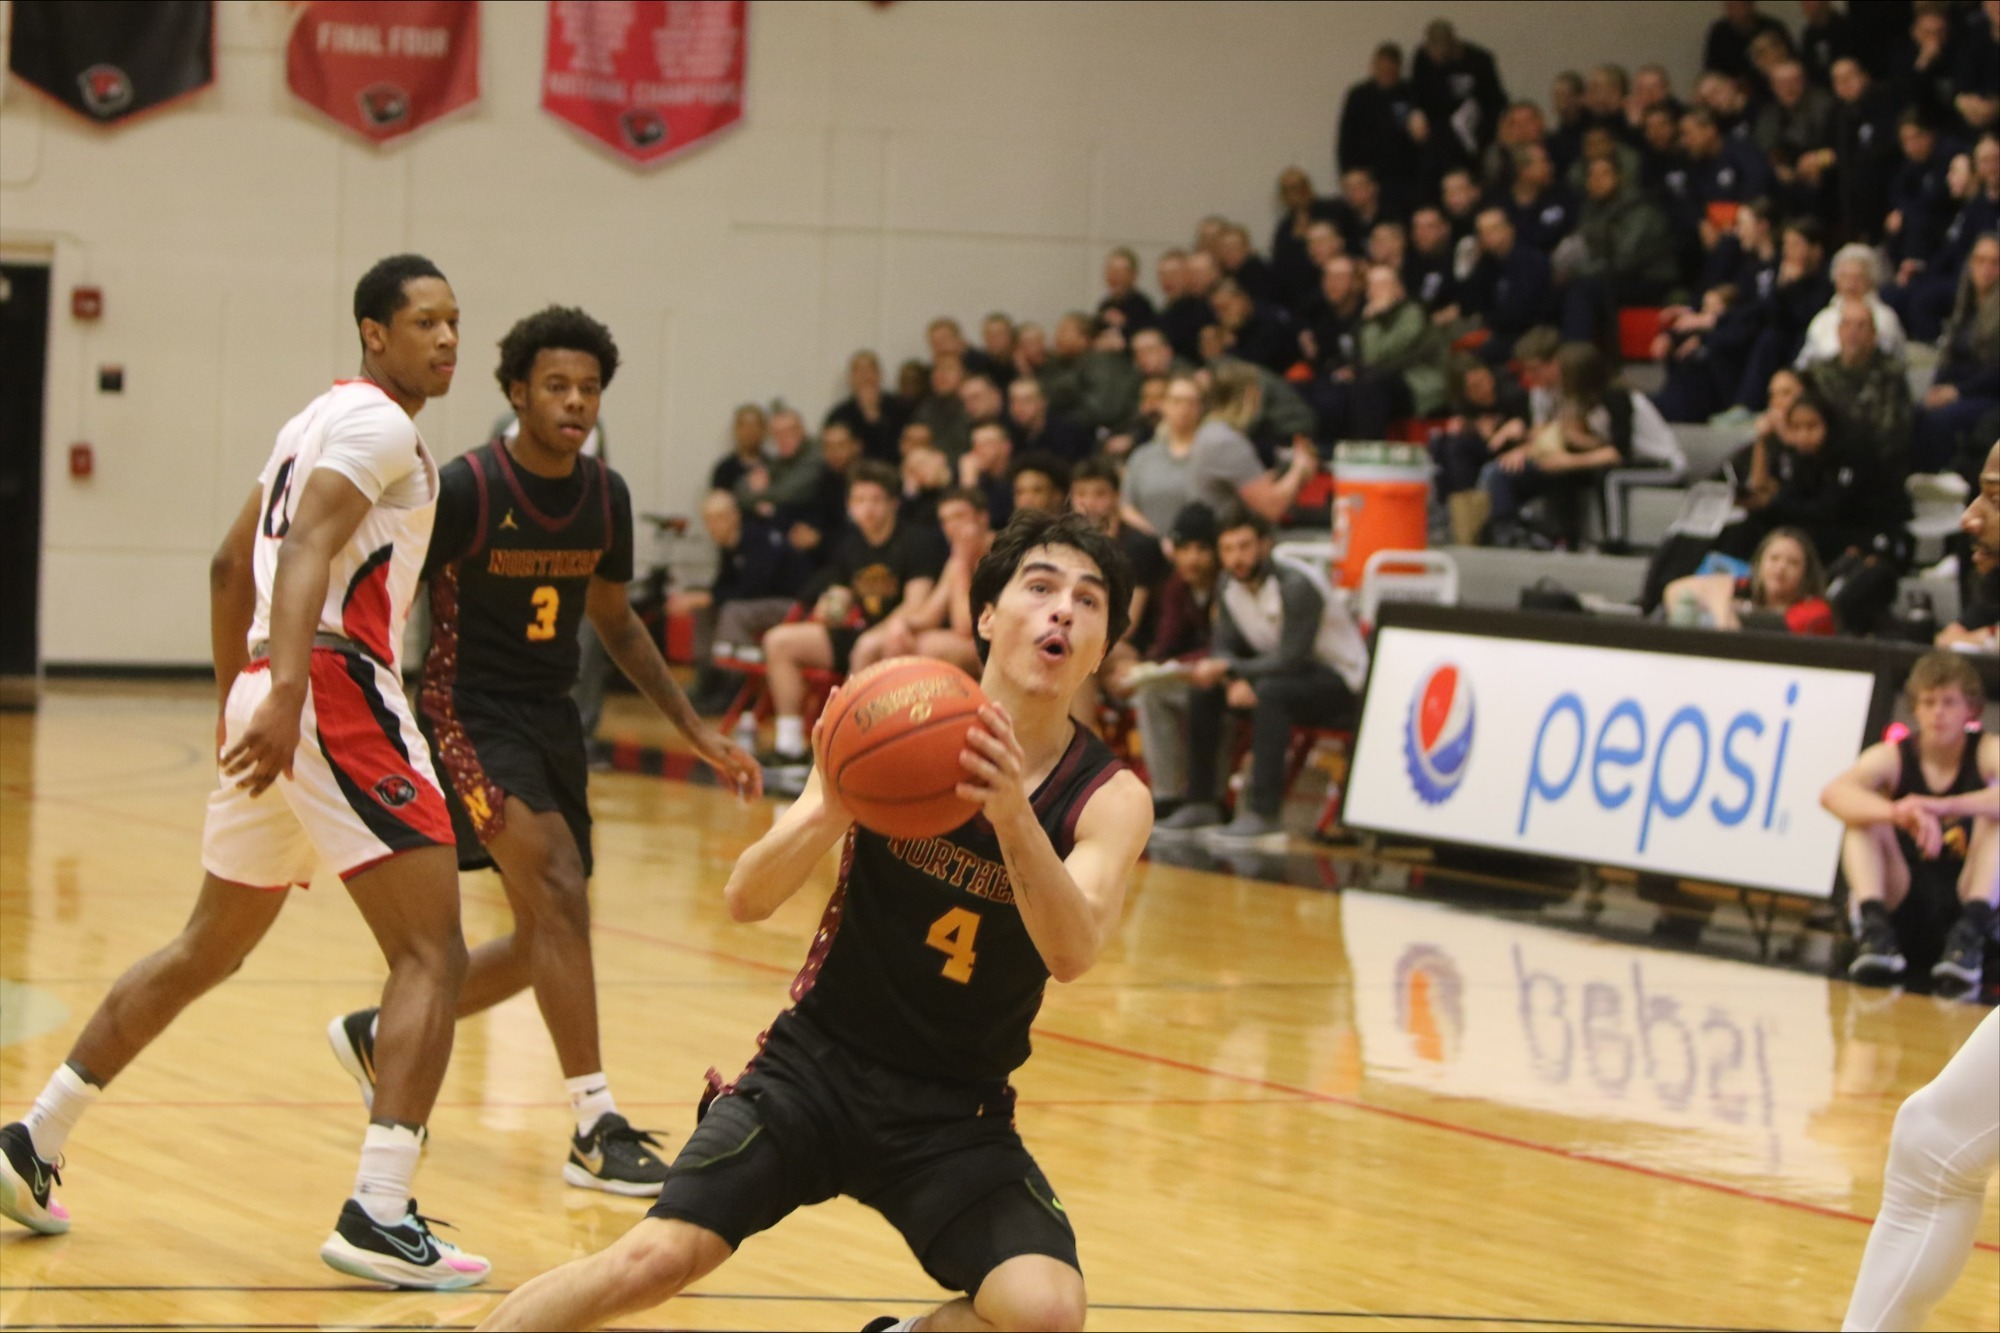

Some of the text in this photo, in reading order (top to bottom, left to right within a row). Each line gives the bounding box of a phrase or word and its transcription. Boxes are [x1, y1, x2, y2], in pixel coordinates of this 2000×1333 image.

[526, 585, 560, 641] 3
[1517, 681, 1799, 853] pepsi
[887, 836, 1016, 905] NORTHE
[924, 906, 981, 984] 4
